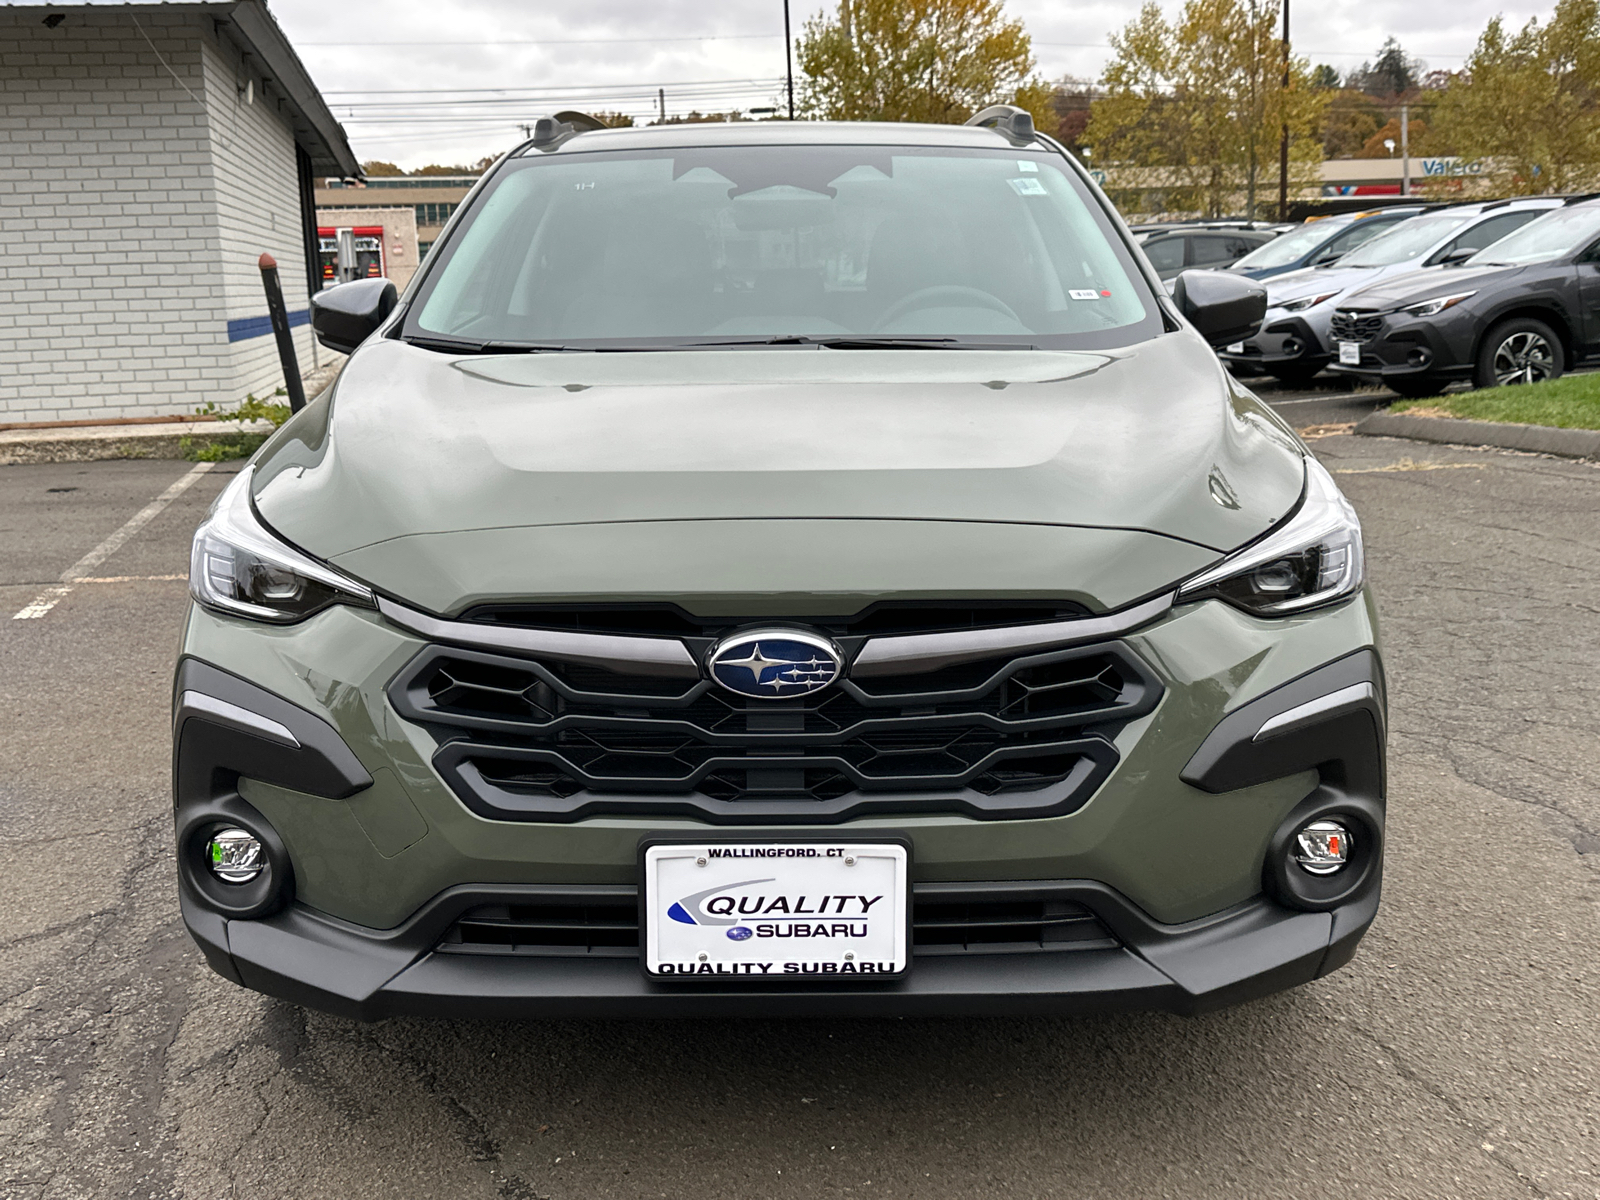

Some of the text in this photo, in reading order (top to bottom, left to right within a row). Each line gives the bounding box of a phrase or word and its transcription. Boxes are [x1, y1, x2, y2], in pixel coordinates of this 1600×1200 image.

[708, 848, 845, 858] WALLINGFORD, CT
[706, 896, 884, 915] QUALITY
[756, 924, 867, 938] SUBARU
[658, 962, 895, 974] QUALITY SUBARU
